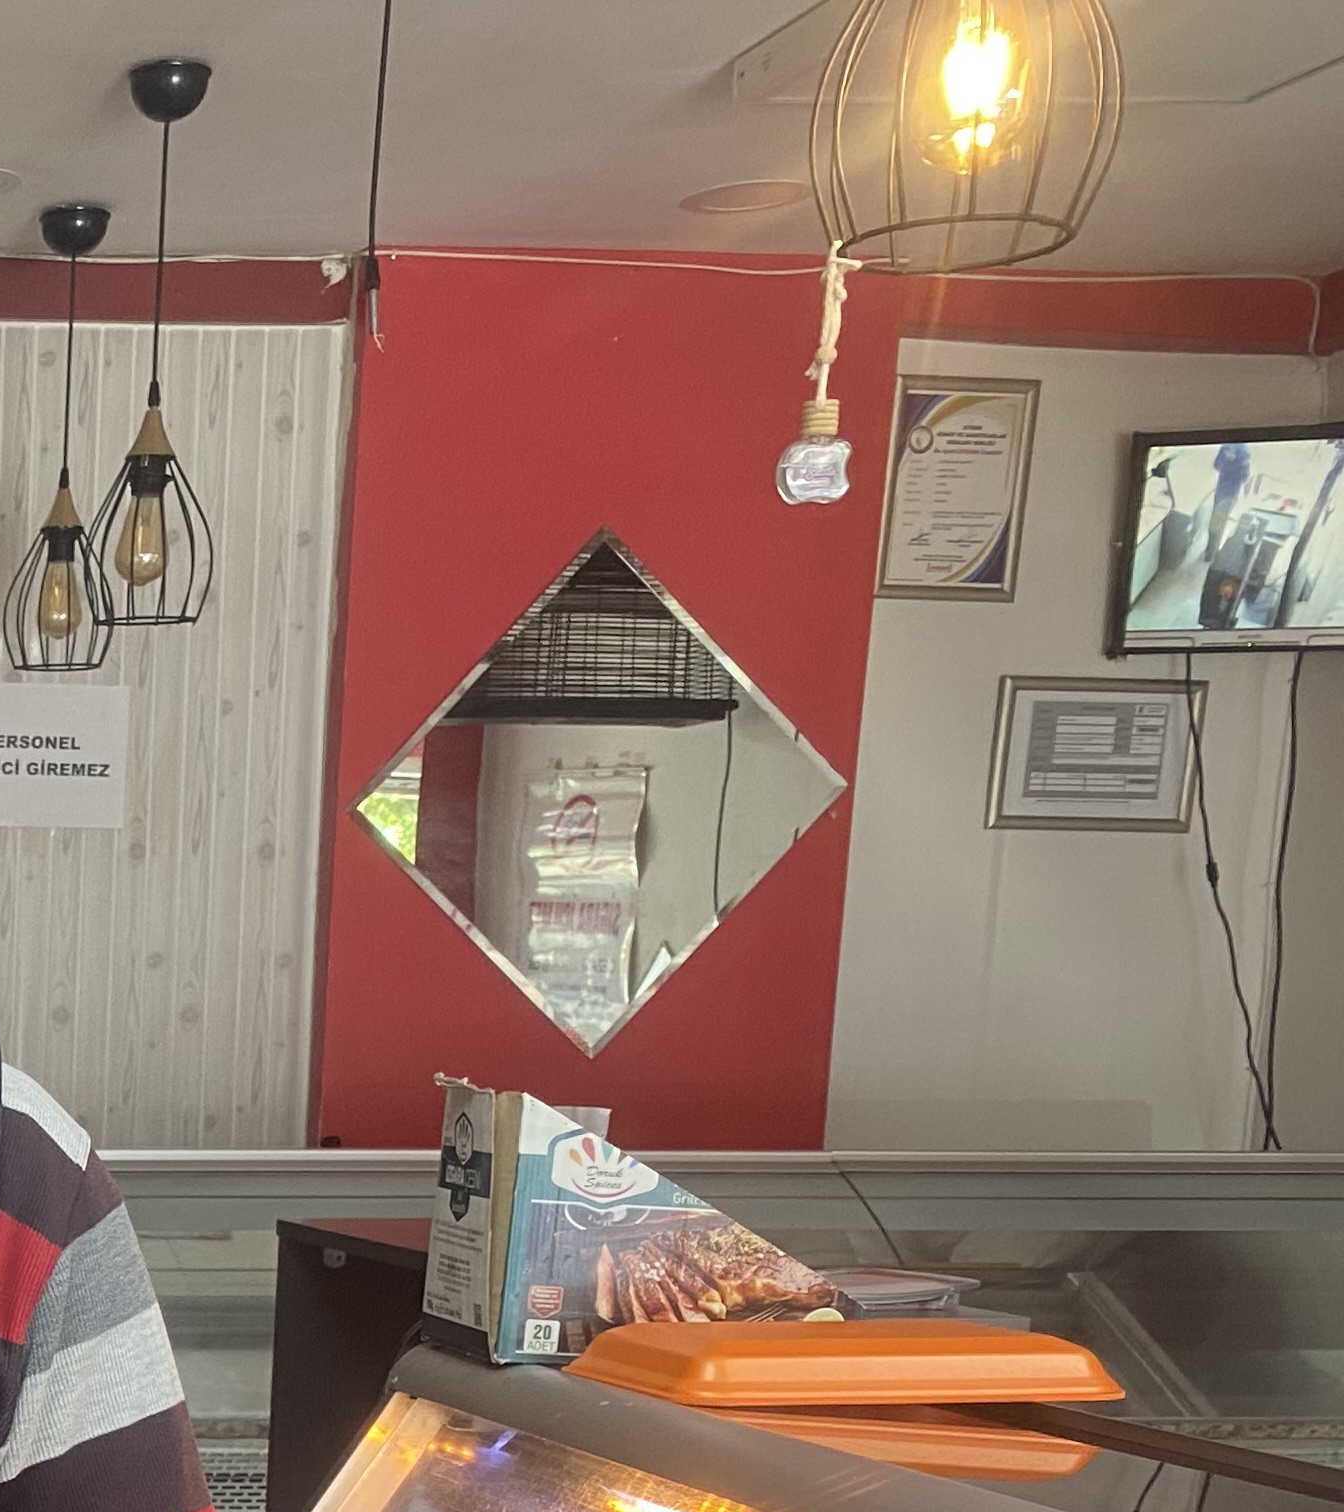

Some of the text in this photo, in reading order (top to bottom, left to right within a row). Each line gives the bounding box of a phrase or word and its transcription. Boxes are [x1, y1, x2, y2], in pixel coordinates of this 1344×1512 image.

[26, 759, 110, 777] GİREMEZ
[533, 1324, 552, 1340] 20
[526, 1340, 556, 1352] ADET
